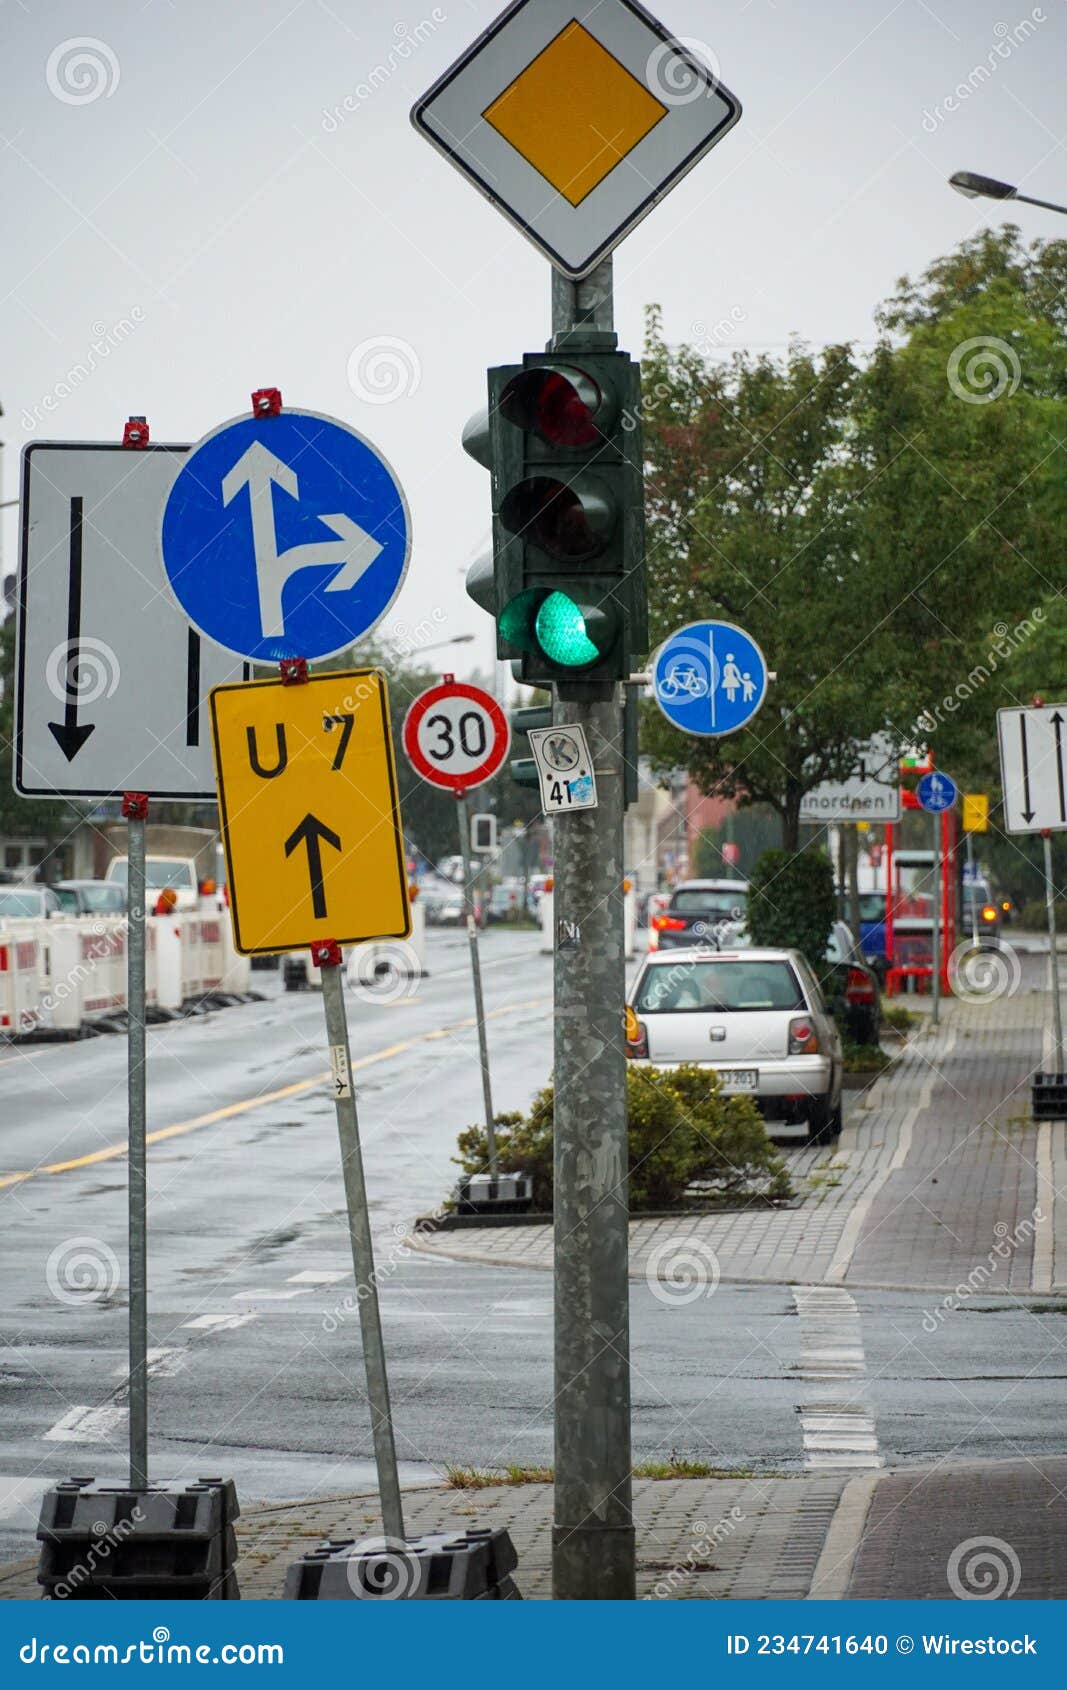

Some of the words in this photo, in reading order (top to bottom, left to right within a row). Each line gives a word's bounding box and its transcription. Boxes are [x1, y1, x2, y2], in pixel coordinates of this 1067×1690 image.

[246, 723, 288, 779] U
[323, 714, 354, 771] 7
[427, 711, 486, 760] 30
[549, 739, 573, 766] K
[803, 793, 893, 811] inordnen!
